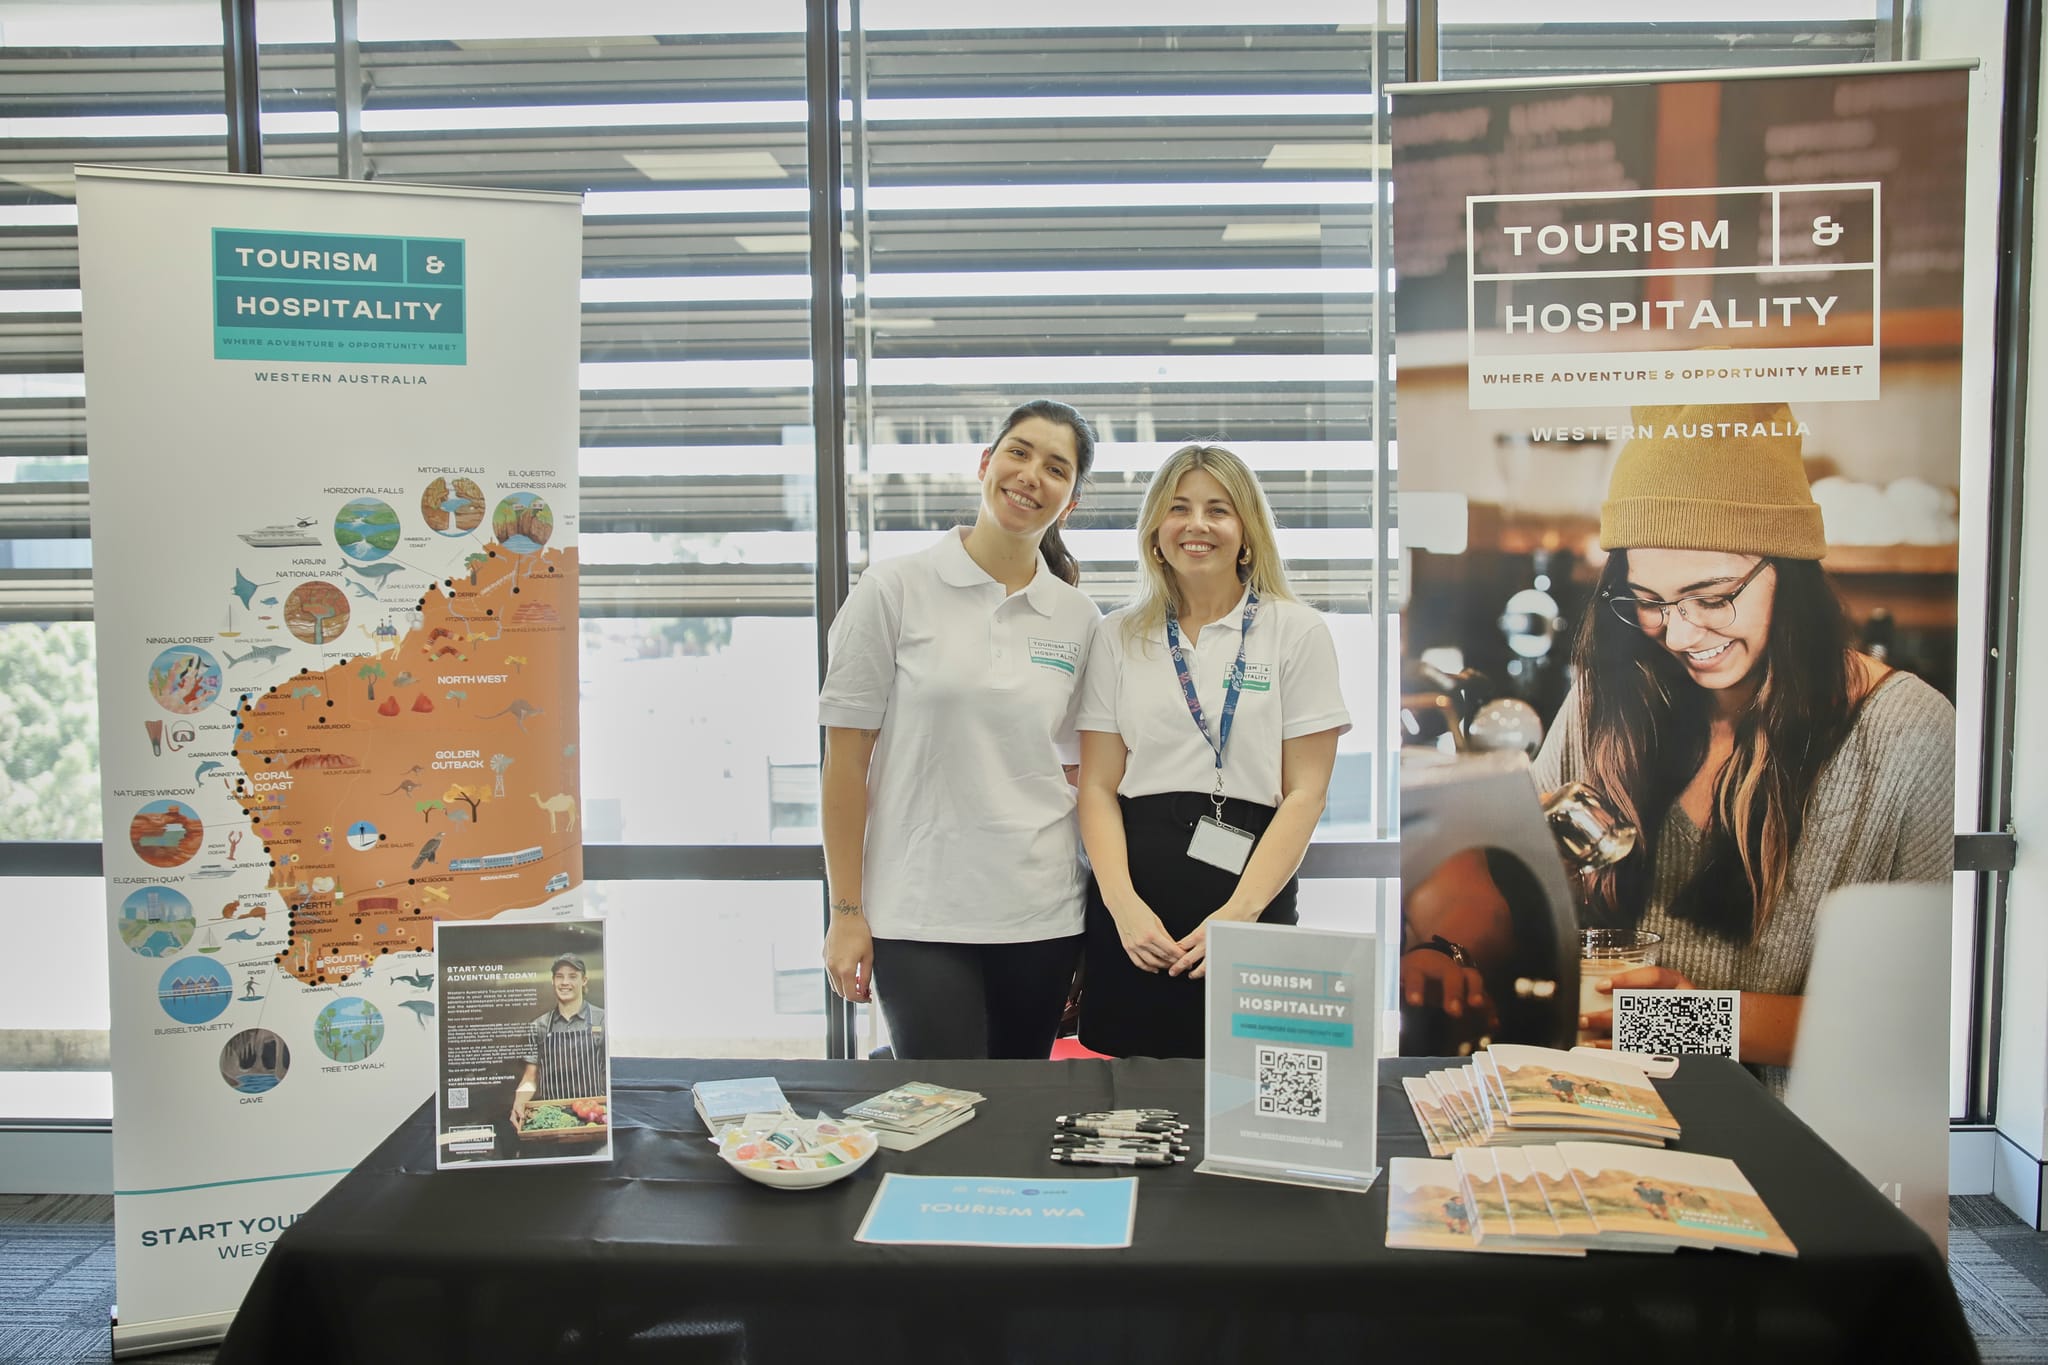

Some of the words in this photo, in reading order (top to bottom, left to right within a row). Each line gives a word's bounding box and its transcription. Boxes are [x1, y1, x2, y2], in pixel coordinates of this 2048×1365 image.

[1503, 220, 1730, 256] TOURISM
[1811, 215, 1844, 247] &
[235, 247, 377, 272] TOURISM
[425, 255, 445, 274] &
[236, 296, 443, 321] HOSPITALITY
[1505, 295, 1838, 335] HOSPITALITY
[223, 338, 263, 346] WHERE
[267, 339, 334, 348] ADVENTURE
[348, 341, 425, 350] OPPORTUNITY
[428, 343, 457, 351] MEET
[255, 372, 332, 383] WESTERN
[337, 374, 427, 385] AUSTRALIA
[1482, 373, 1545, 384] WHERE
[1551, 370, 1658, 383] ADVENTURE
[1664, 370, 1675, 380] &
[1681, 366, 1808, 380] OPPORTUNITY
[1814, 365, 1864, 377] MEET
[1531, 425, 1654, 442] WESTERN
[1663, 422, 1812, 439] AUSTRALIA
[417, 466, 458, 474] MITCHELL
[1033, 641, 1065, 649] TOURISM
[437, 675, 476, 684] NORTH
[476, 674, 508, 684] WEST
[435, 750, 480, 760] GOLDEN
[431, 760, 484, 770] OUTBACK
[254, 771, 293, 781] CORAL
[254, 781, 294, 792] COAST
[113, 789, 156, 797] NATURE'S
[156, 788, 196, 796] WINDOW
[113, 877, 160, 885] ELIZABETH
[299, 901, 332, 909] PERTH
[324, 954, 362, 964] SOUTH
[327, 965, 359, 975] WEST
[447, 965, 477, 973] START
[478, 964, 503, 972] YOUR
[447, 973, 501, 982] ADVENTURE
[502, 972, 537, 980] TODAY!
[1240, 972, 1313, 990] TOURISM
[1334, 980, 1346, 993] &
[1240, 996, 1345, 1018] HOSPITALITY
[154, 1025, 207, 1036] BUSSELTON
[206, 1022, 234, 1032] JETTY
[342, 1064, 360, 1072] TOP
[239, 1097, 263, 1105] CAVE
[920, 1202, 1033, 1217] TOURISM
[1041, 1207, 1086, 1217] WA
[141, 1221, 233, 1247] START
